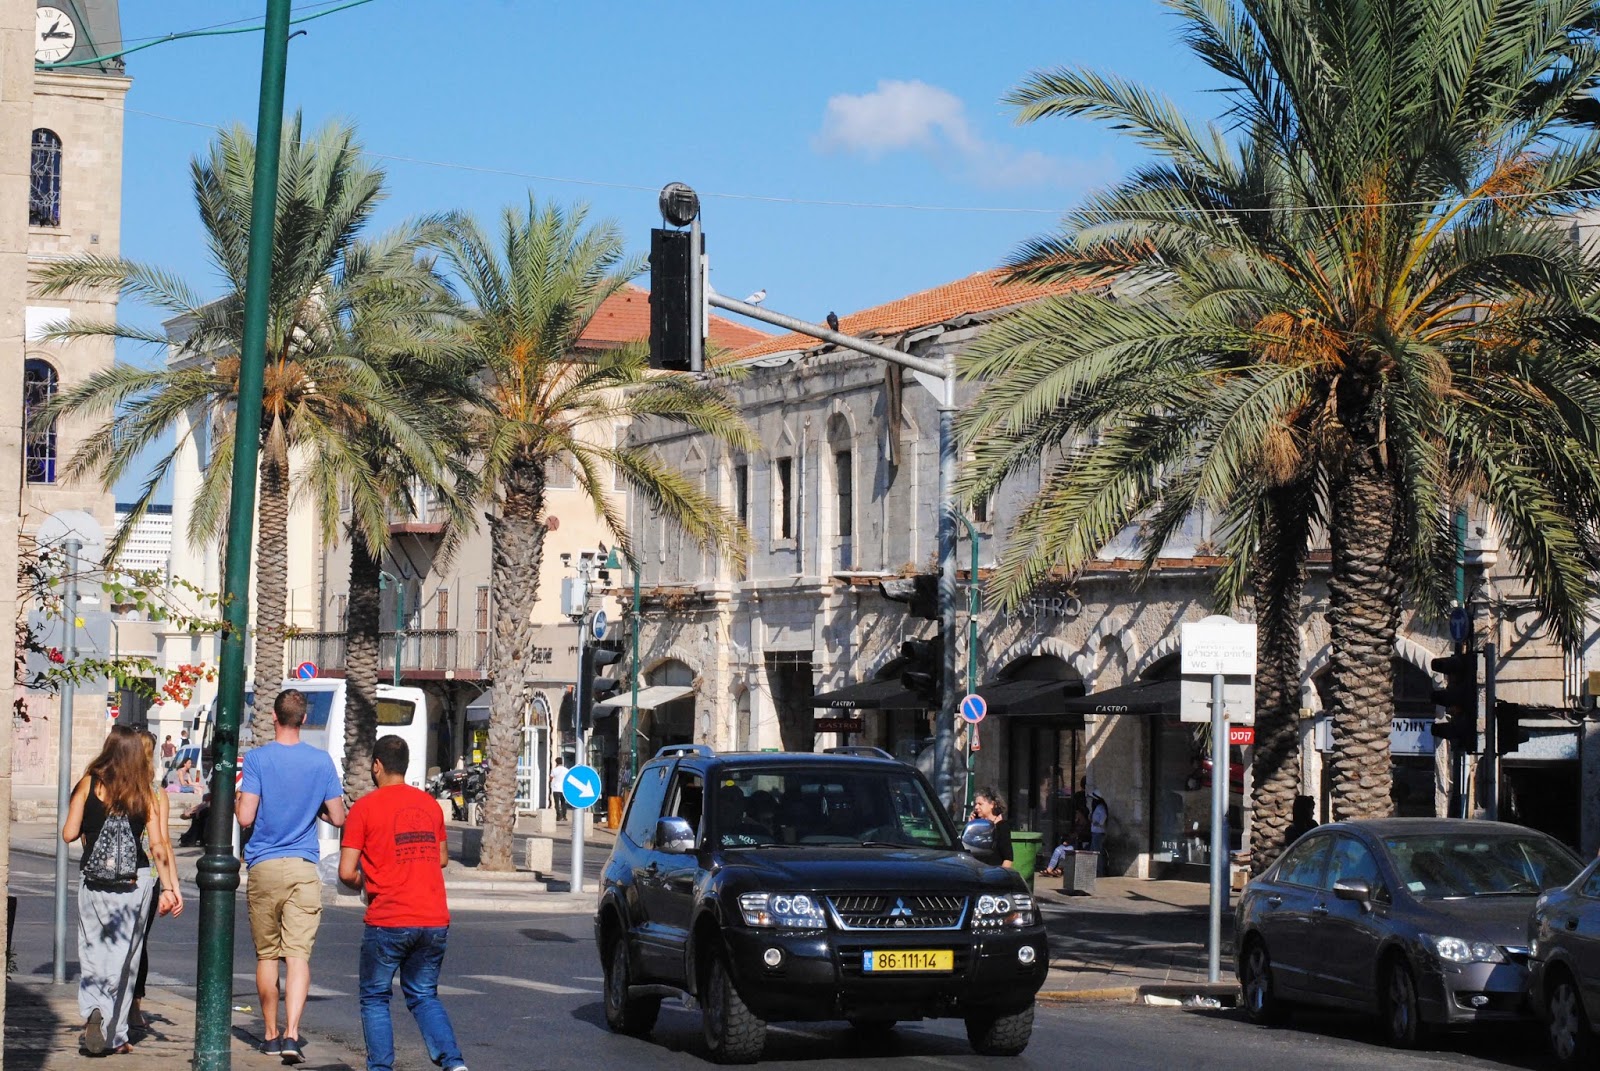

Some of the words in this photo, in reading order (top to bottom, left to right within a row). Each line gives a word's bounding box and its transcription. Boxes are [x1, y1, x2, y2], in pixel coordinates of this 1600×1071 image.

[1001, 597, 1083, 618] CASTRO
[818, 721, 858, 729] CASTRO
[475, 730, 489, 738] CHA
[1230, 731, 1252, 741] קסט
